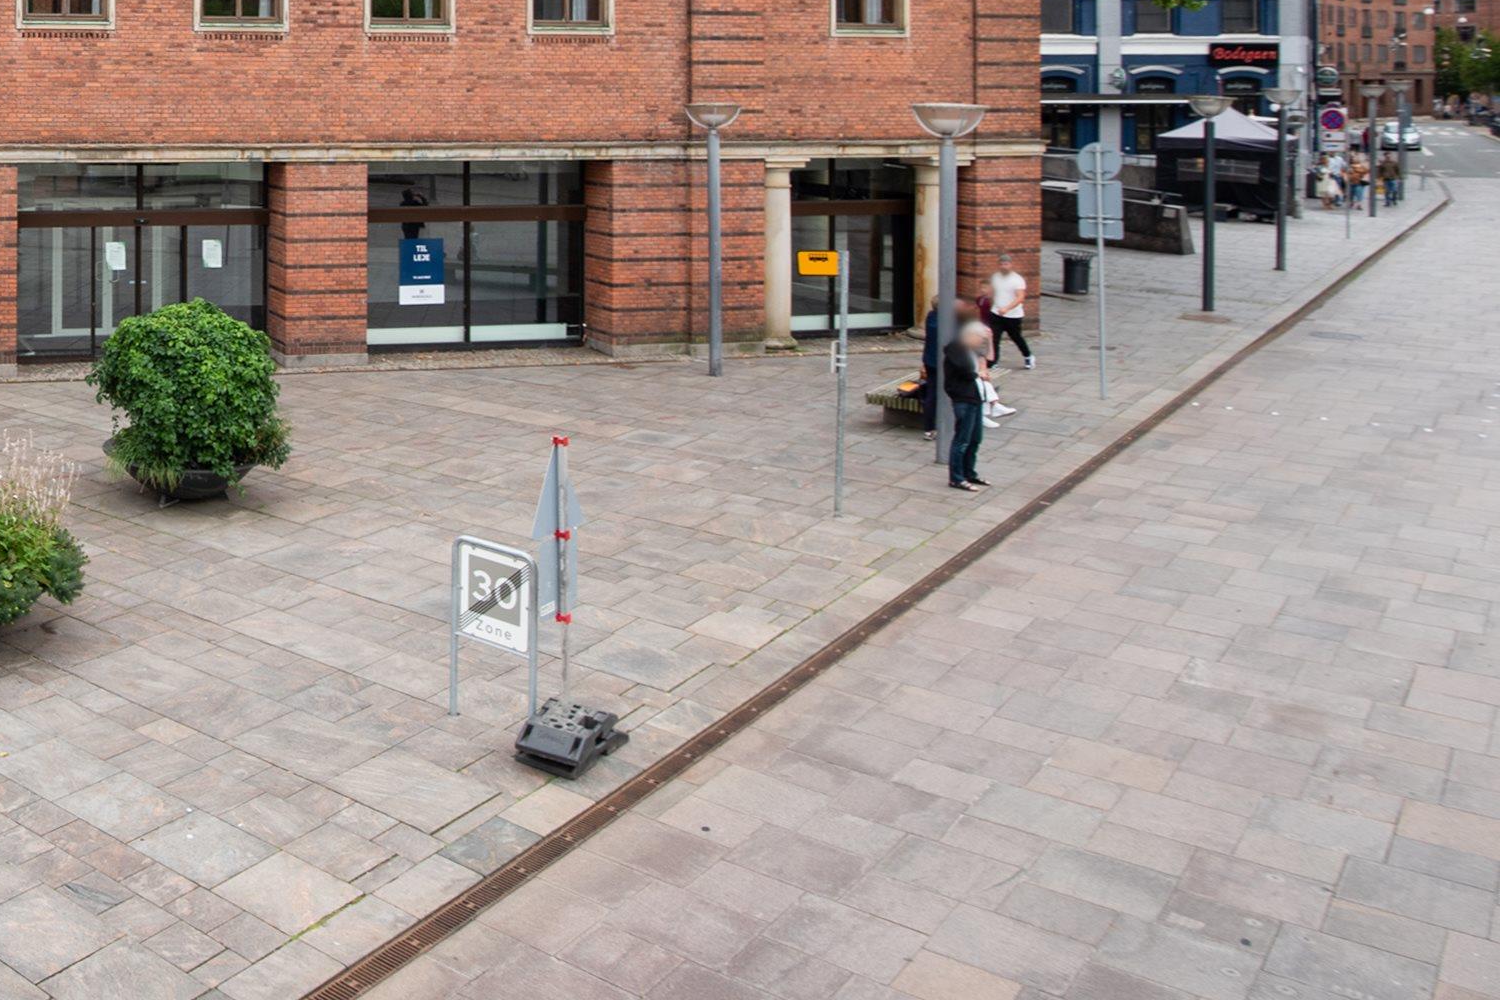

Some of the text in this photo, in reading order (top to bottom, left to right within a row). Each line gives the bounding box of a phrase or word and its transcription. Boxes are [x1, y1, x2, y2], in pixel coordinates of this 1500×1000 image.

[1213, 46, 1277, 63] Bodegaen
[415, 244, 428, 252] TIL
[412, 253, 430, 261] LEJE
[472, 569, 518, 610] 30
[474, 618, 513, 641] Zone
